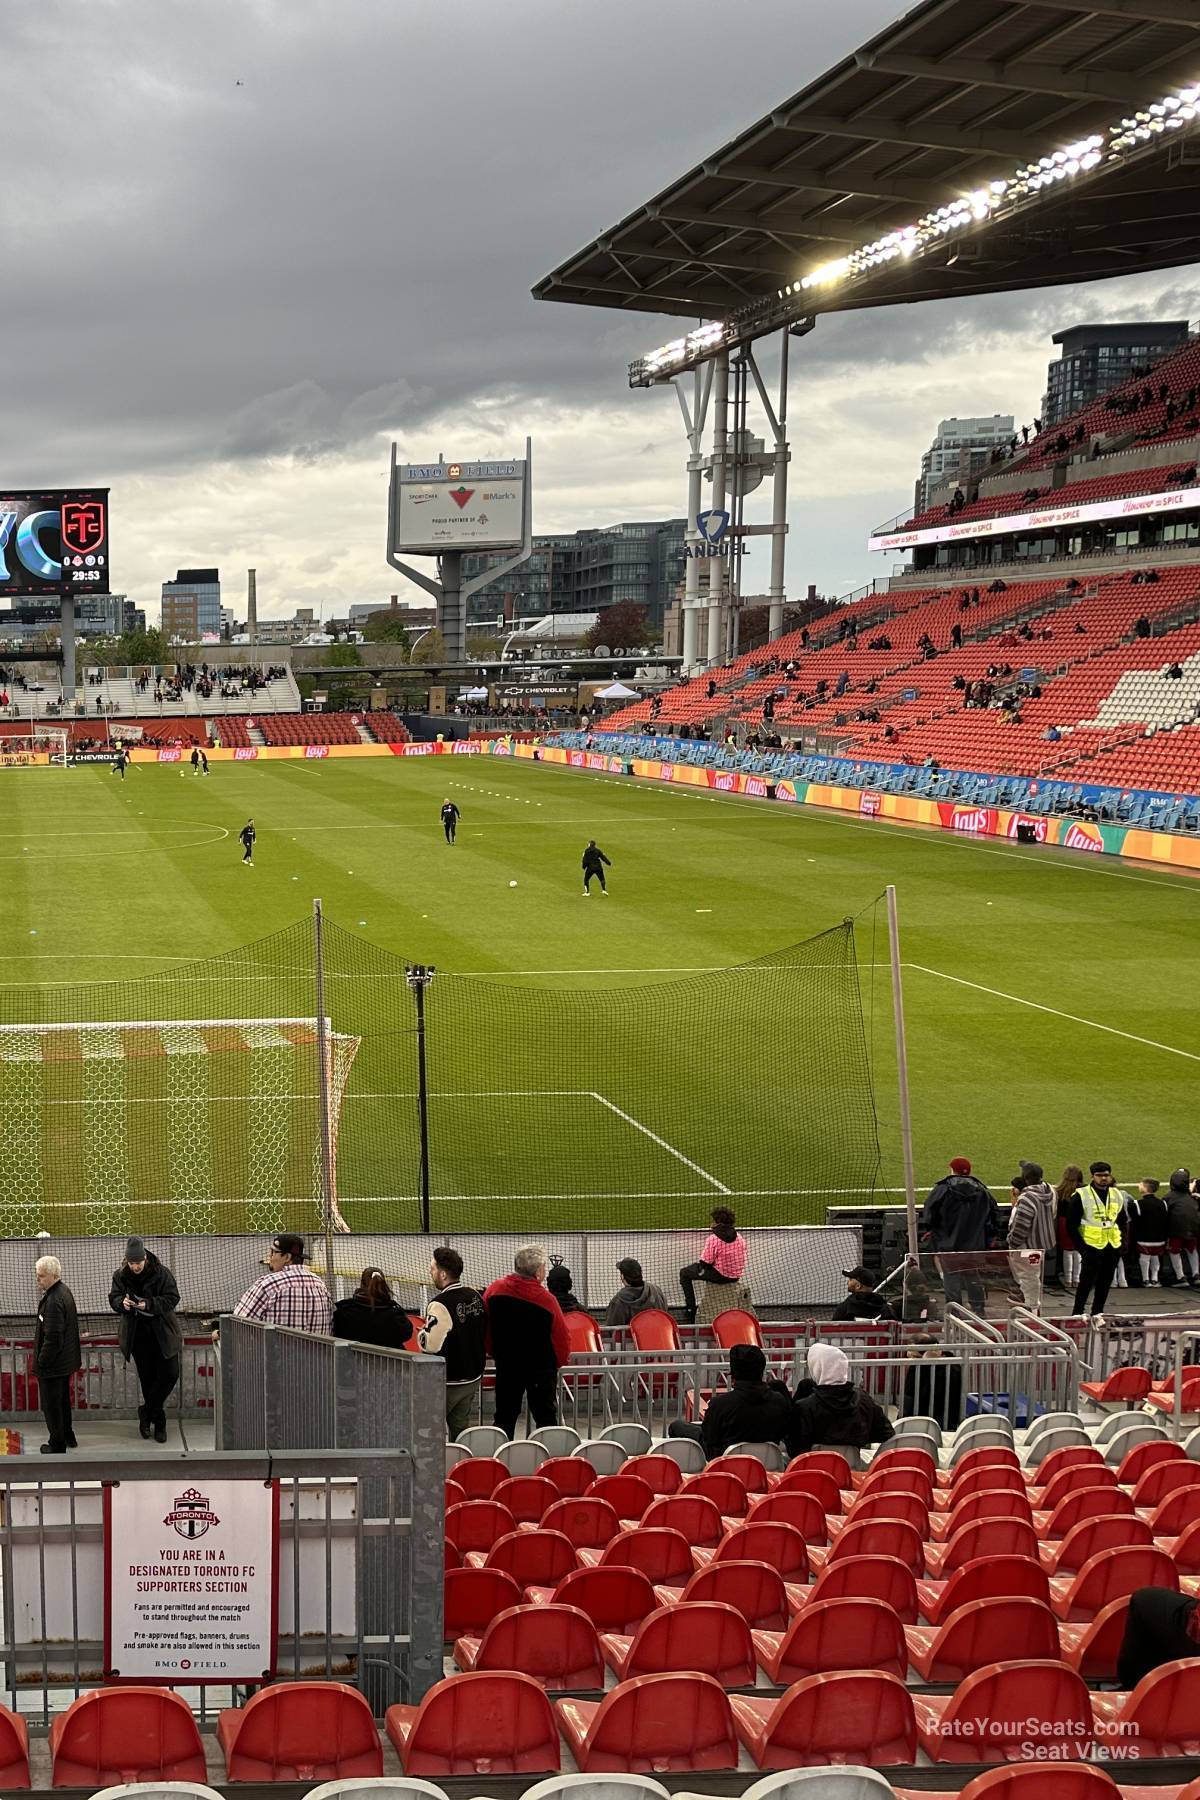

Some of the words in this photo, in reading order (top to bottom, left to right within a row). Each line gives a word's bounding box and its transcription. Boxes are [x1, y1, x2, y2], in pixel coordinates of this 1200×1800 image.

[408, 467, 442, 479] BMO
[467, 464, 515, 476] FIELD
[1163, 494, 1184, 507] SPICE
[63, 556, 70, 567] 0
[97, 556, 104, 566] 0
[72, 570, 100, 581] 29:53
[75, 754, 120, 762] CHEVROLE
[171, 1512, 213, 1520] TORONTO
[160, 1550, 179, 1561] YOU
[182, 1550, 202, 1560] ARE
[205, 1550, 216, 1560] IN
[218, 1550, 225, 1560] A
[129, 1565, 190, 1577] DESIGNATED
[193, 1566, 239, 1577] TORONTO
[242, 1566, 255, 1577] FC
[136, 1581, 202, 1592] SUPPORTERS
[205, 1582, 248, 1593] SECTION
[134, 1603, 150, 1611] Fans
[163, 1603, 196, 1613] permitted
[197, 1603, 210, 1611] and
[211, 1603, 250, 1613] encouraged
[150, 1613, 169, 1621] stand
[170, 1613, 207, 1622] throughout
[208, 1613, 219, 1621] the
[220, 1613, 241, 1621] match
[134, 1632, 179, 1642] Pre-approved
[179, 1632, 198, 1642] flags,
[199, 1632, 228, 1641] banners,
[229, 1632, 250, 1640] drums
[235, 1642, 261, 1650] section
